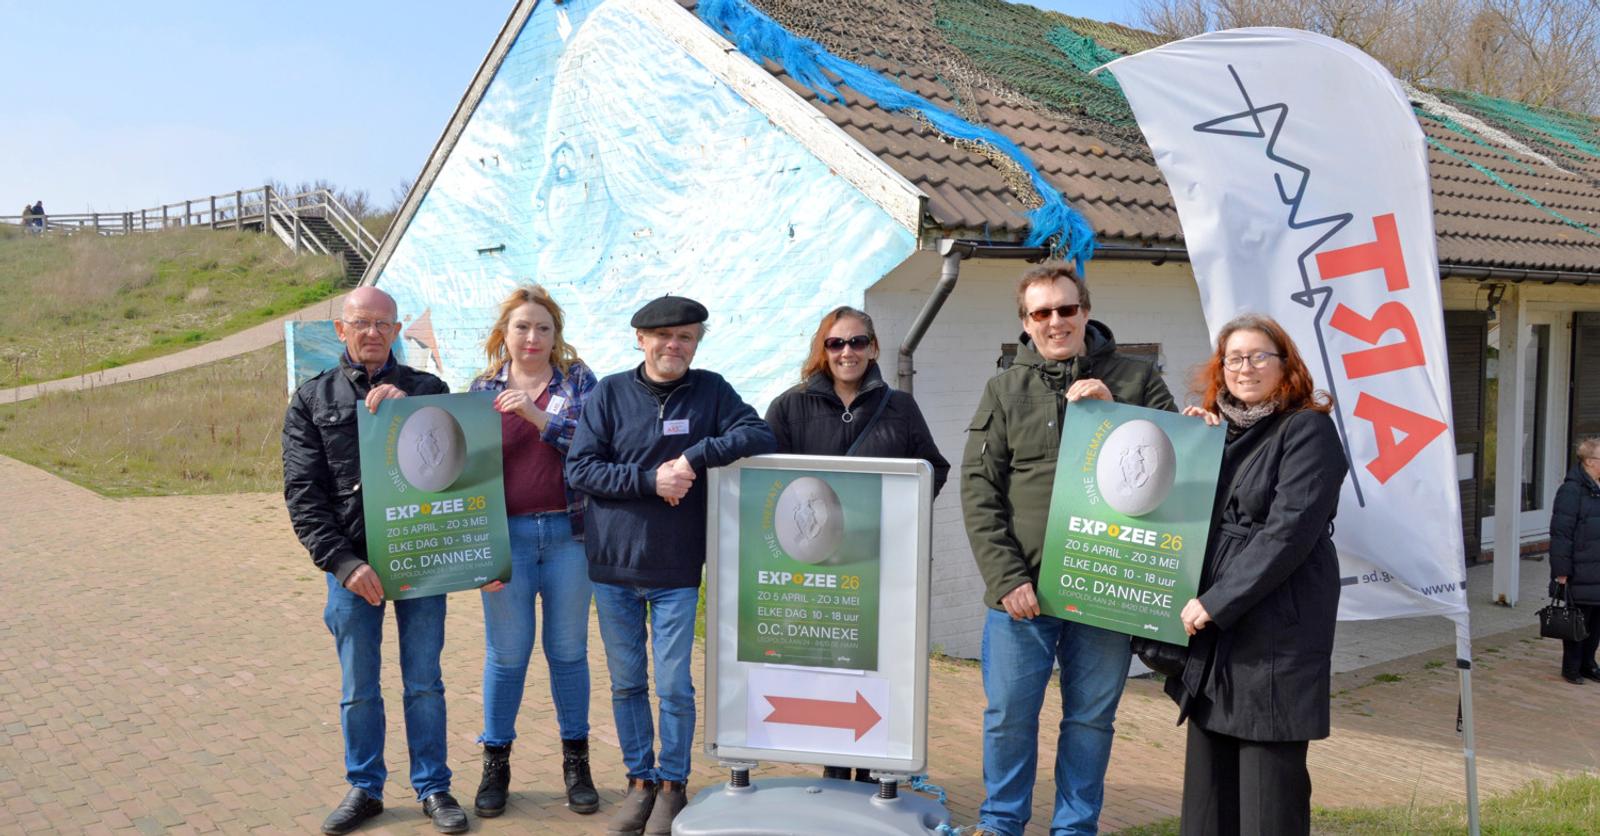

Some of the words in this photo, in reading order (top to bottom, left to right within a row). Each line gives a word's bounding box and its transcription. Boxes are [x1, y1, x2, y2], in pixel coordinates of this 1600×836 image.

[1082, 418, 1113, 473] THEMATE
[388, 469, 407, 494] SINE
[1084, 476, 1099, 505] SINE
[385, 498, 464, 521] EXPOZEE
[467, 496, 486, 511] 26
[387, 528, 400, 538] ZO
[402, 526, 409, 535] 5
[410, 522, 438, 534] APRIL
[446, 520, 460, 529] ZO
[462, 518, 468, 527] 3
[470, 516, 488, 526] MEI
[1068, 516, 1158, 547] EXPOZEE
[1160, 533, 1183, 551] 26
[388, 539, 413, 553] ELKE
[416, 537, 438, 549] DAG
[443, 536, 453, 545] 10
[462, 533, 472, 543] 18
[473, 533, 489, 542] uur
[764, 532, 782, 559] SINE
[1065, 539, 1081, 551] ZO
[1083, 543, 1089, 553] 5
[1090, 544, 1122, 559] APRIL
[1131, 552, 1147, 564] ZO
[1150, 555, 1156, 566] 3
[1158, 556, 1180, 570] MEI
[390, 557, 417, 572] O.C.
[420, 547, 492, 568] D'ANNEXE
[1063, 556, 1091, 571] ELKE
[1093, 561, 1117, 576] DAG
[1123, 568, 1134, 579] 10
[1144, 573, 1156, 584] 18
[1158, 577, 1176, 588] uur
[758, 570, 837, 588] EXPOZEE
[841, 575, 860, 590] 26
[1060, 574, 1088, 592] O.C.
[1093, 580, 1173, 609] D'ANNEXE
[757, 591, 771, 601] ZO
[773, 592, 779, 601] 5
[781, 593, 809, 603] APRIL
[816, 595, 832, 604] ZO
[834, 596, 839, 605] 3
[842, 596, 860, 606] MEI
[758, 607, 783, 617] ELKE
[785, 609, 807, 619] DAG
[812, 611, 822, 620] 10
[832, 611, 841, 620] 18
[843, 614, 859, 622] uur
[758, 622, 784, 636] O.C.
[788, 624, 859, 641] D'ANNEXE
